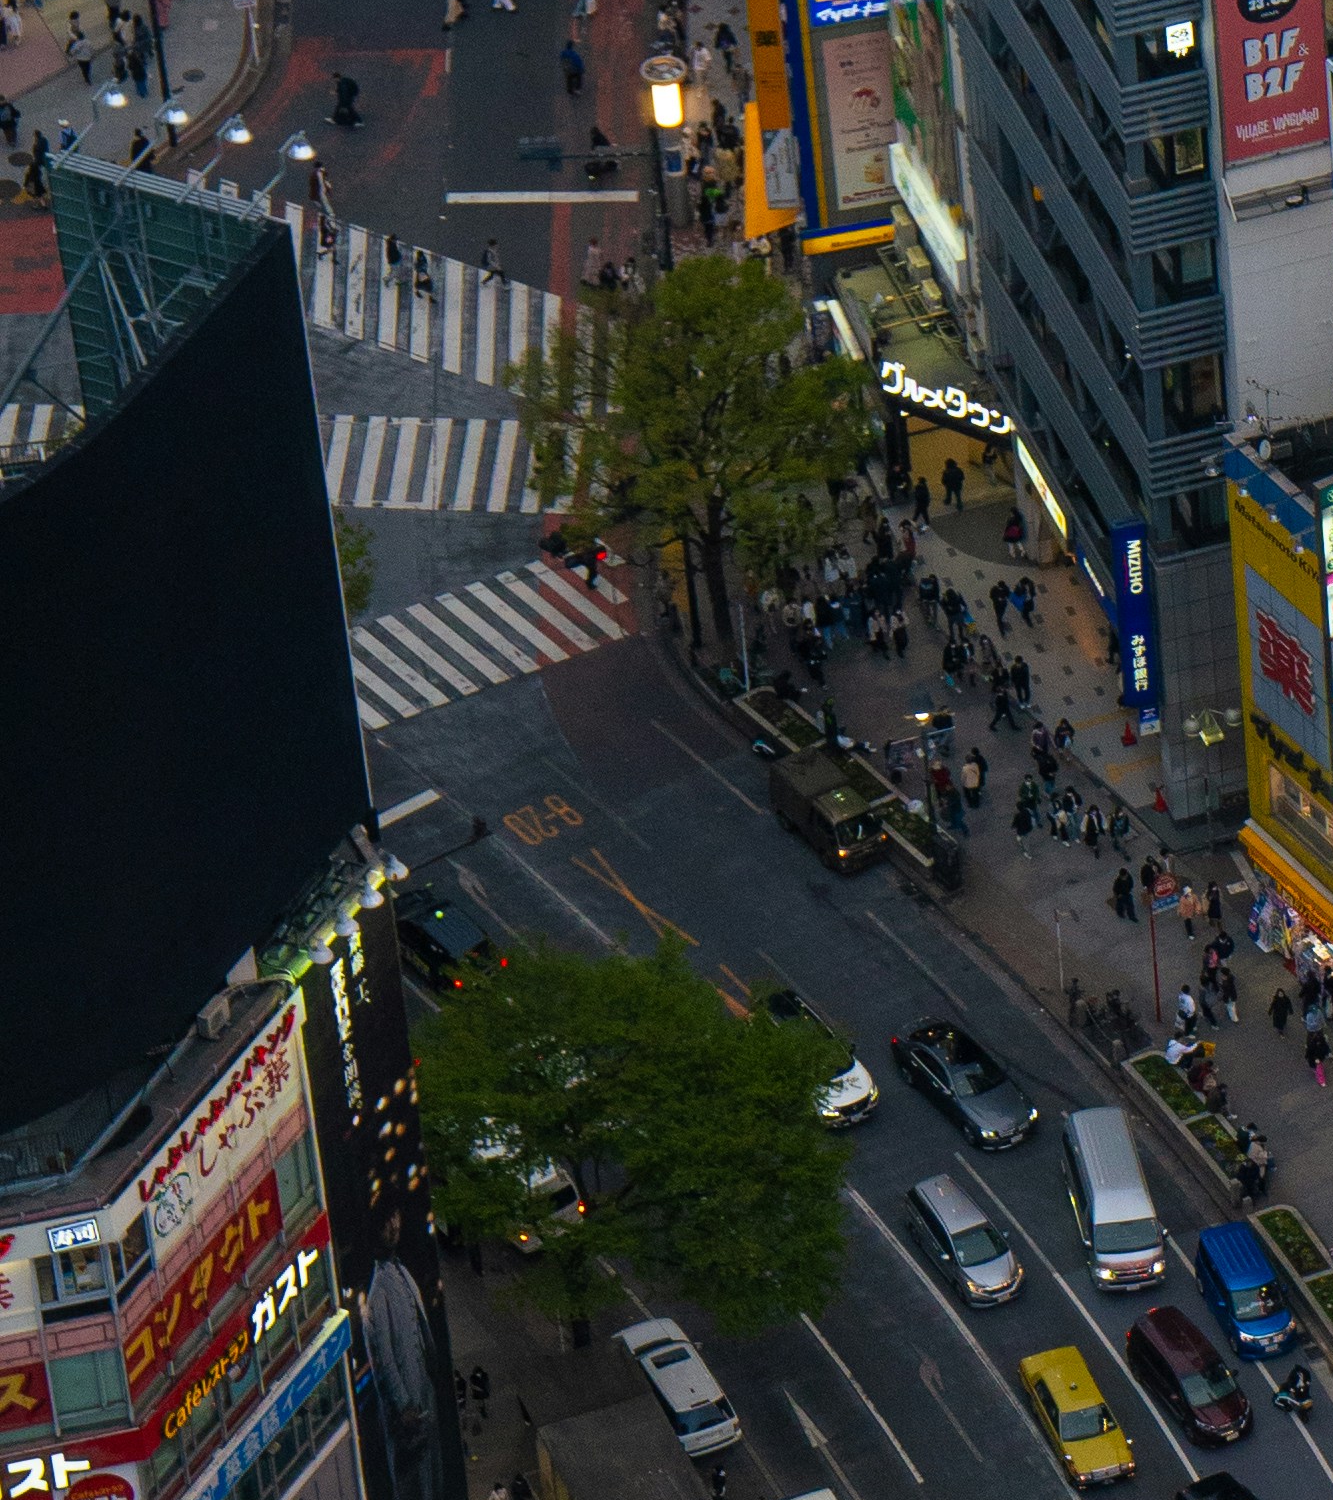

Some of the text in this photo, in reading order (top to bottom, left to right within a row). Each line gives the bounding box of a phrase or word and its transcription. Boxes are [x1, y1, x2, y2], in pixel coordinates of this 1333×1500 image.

[1243, 27, 1300, 69] B1F
[1245, 61, 1304, 102] B2F
[1235, 119, 1270, 142] VILLAGE
[1272, 105, 1320, 132] VANGUARD
[880, 360, 1012, 435] グルメタウン
[1233, 499, 1299, 566] Matsumoto
[1125, 538, 1145, 595] MIZUHO
[1255, 609, 1317, 717] 薬
[124, 1199, 273, 1384] コンタクト
[251, 1246, 319, 1345] ガスト
